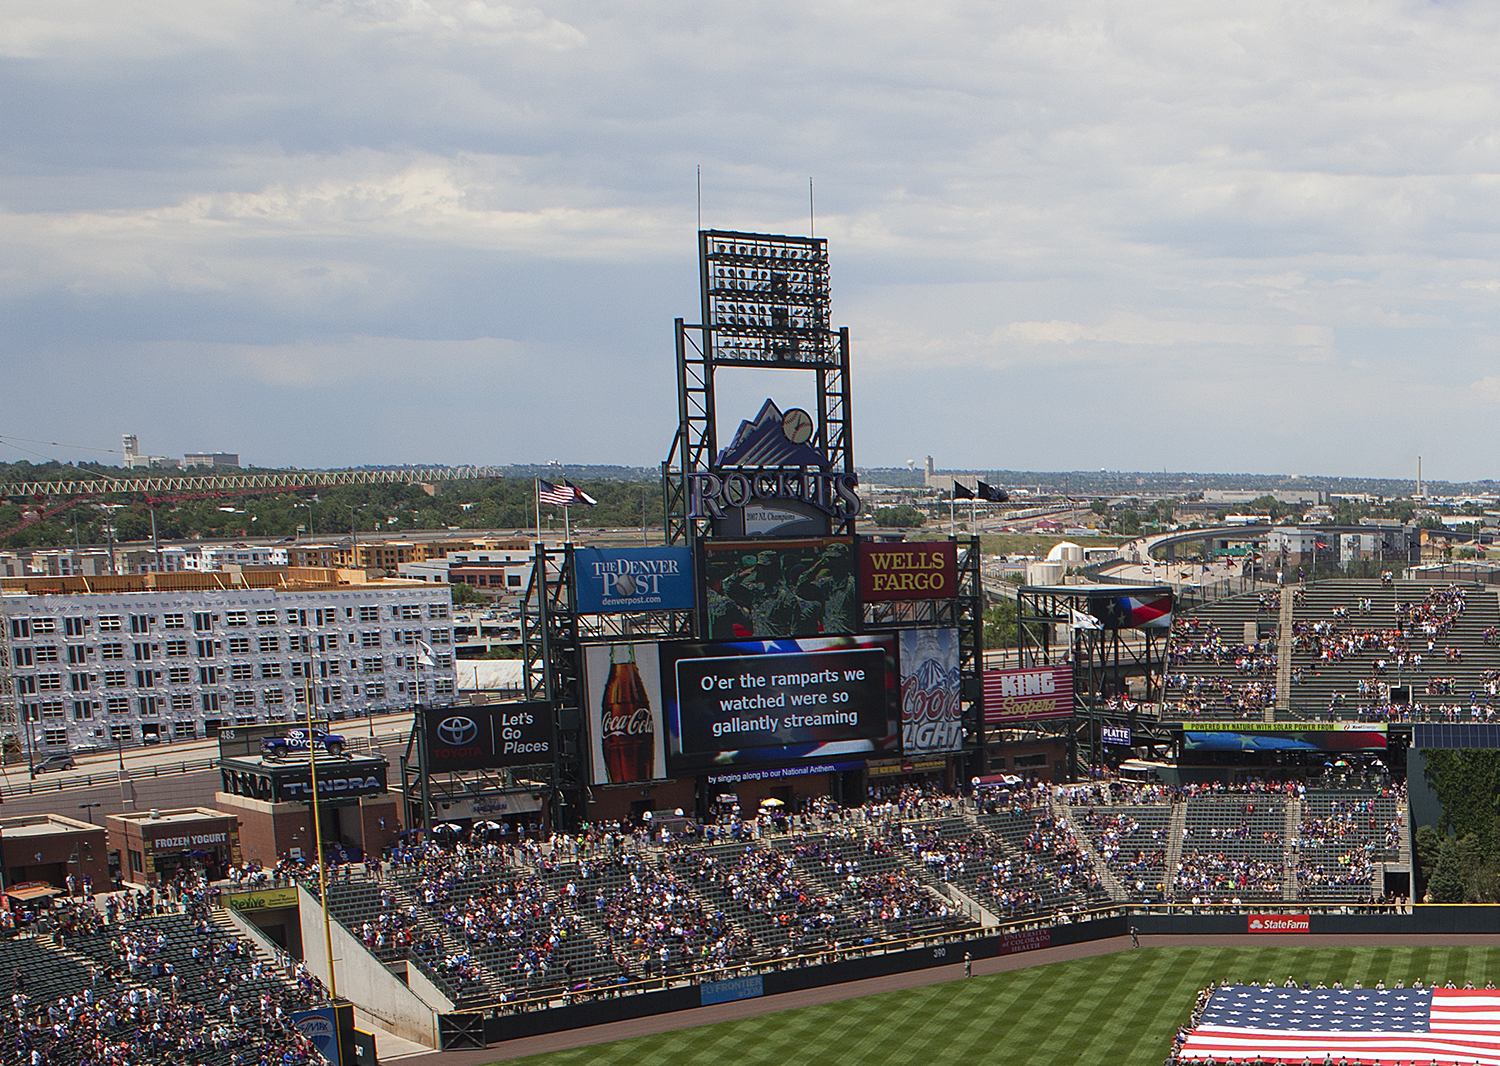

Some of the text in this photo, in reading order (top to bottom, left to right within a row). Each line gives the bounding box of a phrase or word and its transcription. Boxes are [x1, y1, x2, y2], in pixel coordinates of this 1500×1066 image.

[687, 472, 862, 520] ROCKIES
[767, 512, 796, 522] Champions
[591, 558, 680, 576] THE DENVER
[869, 552, 945, 570] WELLS
[872, 573, 944, 591] FARGO
[602, 596, 661, 606] denverpost.com
[701, 669, 865, 691] O'er the ramparts we
[1001, 673, 1055, 697] KING
[720, 691, 849, 712] watched were so
[901, 675, 961, 723] Coors
[1001, 697, 1056, 718] Soopers
[502, 712, 534, 727] Let's
[601, 708, 655, 739] Coca-Cola
[712, 710, 858, 737] gallantly streaming
[1191, 723, 1334, 731] POWERED BY NATURE WITH SOLAR POWER FROM
[221, 730, 235, 740] 485
[502, 728, 522, 740] Go
[903, 721, 962, 750] LIGHT
[1103, 728, 1129, 739] PLATTE
[284, 738, 326, 749] TOYOTA
[503, 741, 549, 755] Places
[433, 747, 483, 759] TOYOTA
[708, 775, 717, 784] by
[717, 773, 742, 784] singing
[742, 771, 761, 781] along
[769, 770, 781, 778] our
[782, 766, 809, 777] National
[283, 776, 380, 795] TUNDRA
[155, 832, 227, 848] FROZEN YOGURT
[1004, 929, 1048, 940] UNIVERSITY
[1010, 934, 1051, 946] COLORADO
[933, 948, 946, 958] 390
[1011, 943, 1041, 952] HEALTH
